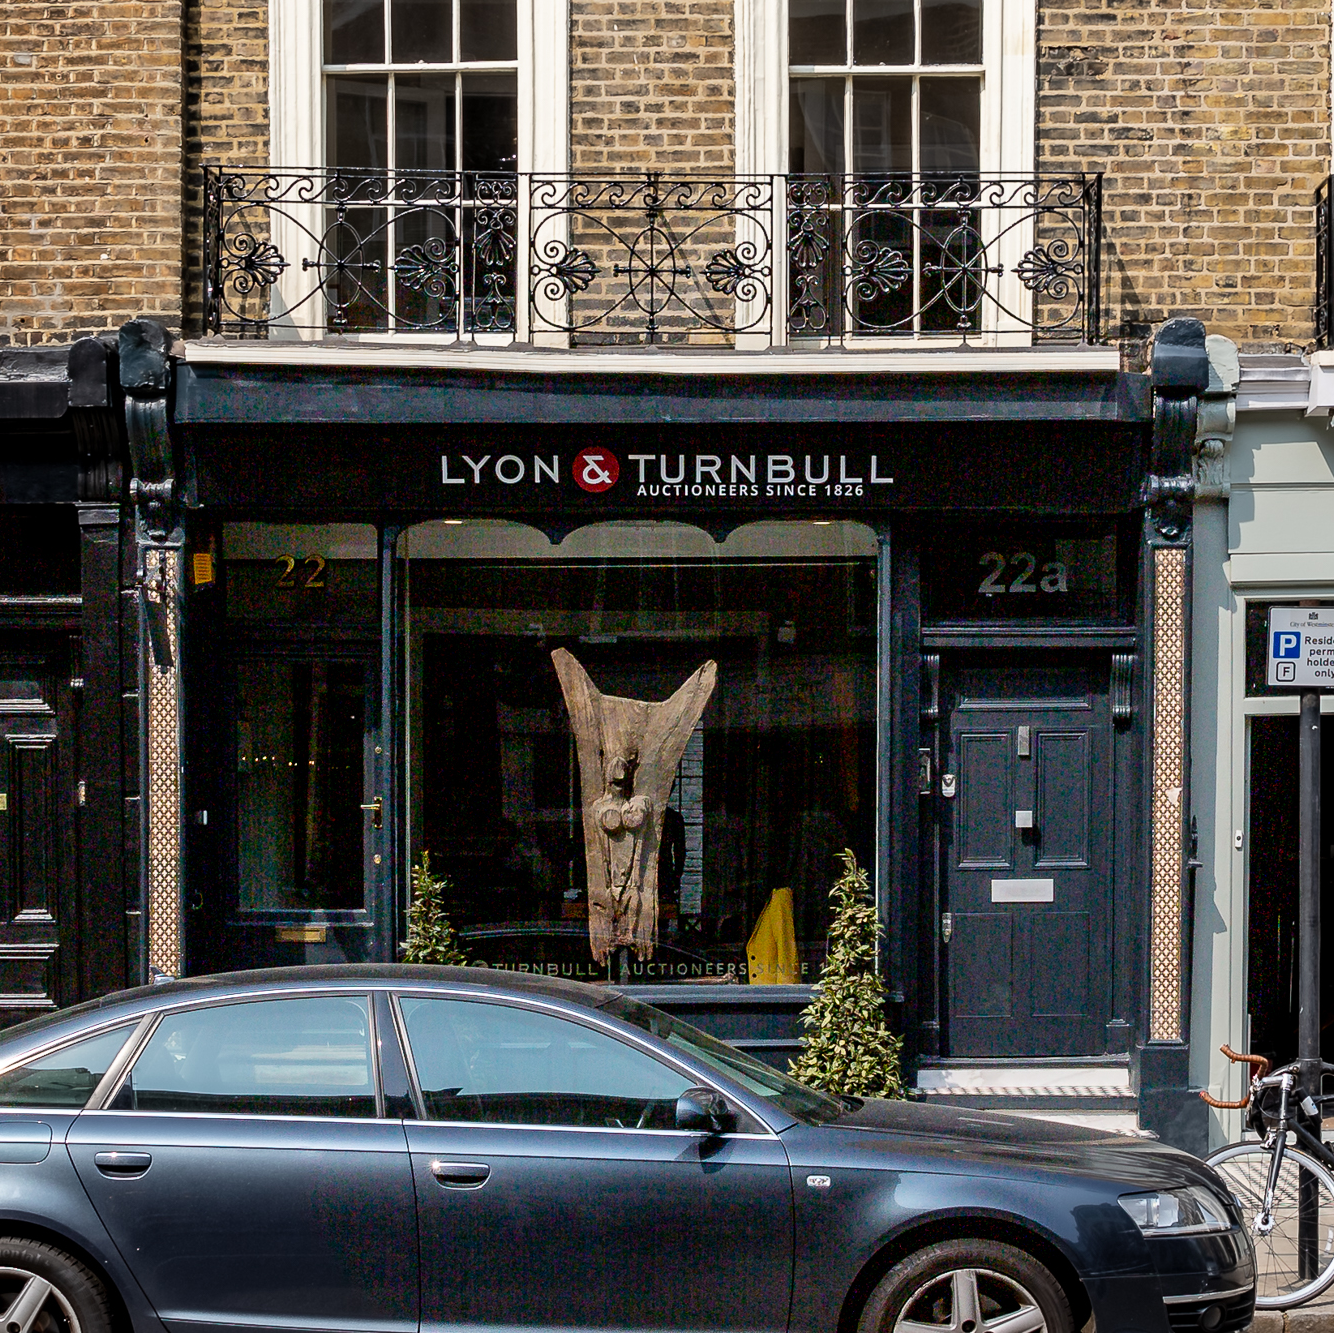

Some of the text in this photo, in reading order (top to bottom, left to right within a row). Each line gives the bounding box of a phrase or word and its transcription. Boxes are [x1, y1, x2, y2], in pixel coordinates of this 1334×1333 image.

[441, 454, 894, 485] LYON & TURNBULL
[637, 484, 864, 497] AUCTIONEERS SINCE 1826
[275, 553, 326, 588] 22
[978, 551, 1068, 593] 22a
[1279, 634, 1297, 657] P
[1283, 667, 1291, 677] F
[619, 962, 747, 975] AUCTIONEERS
